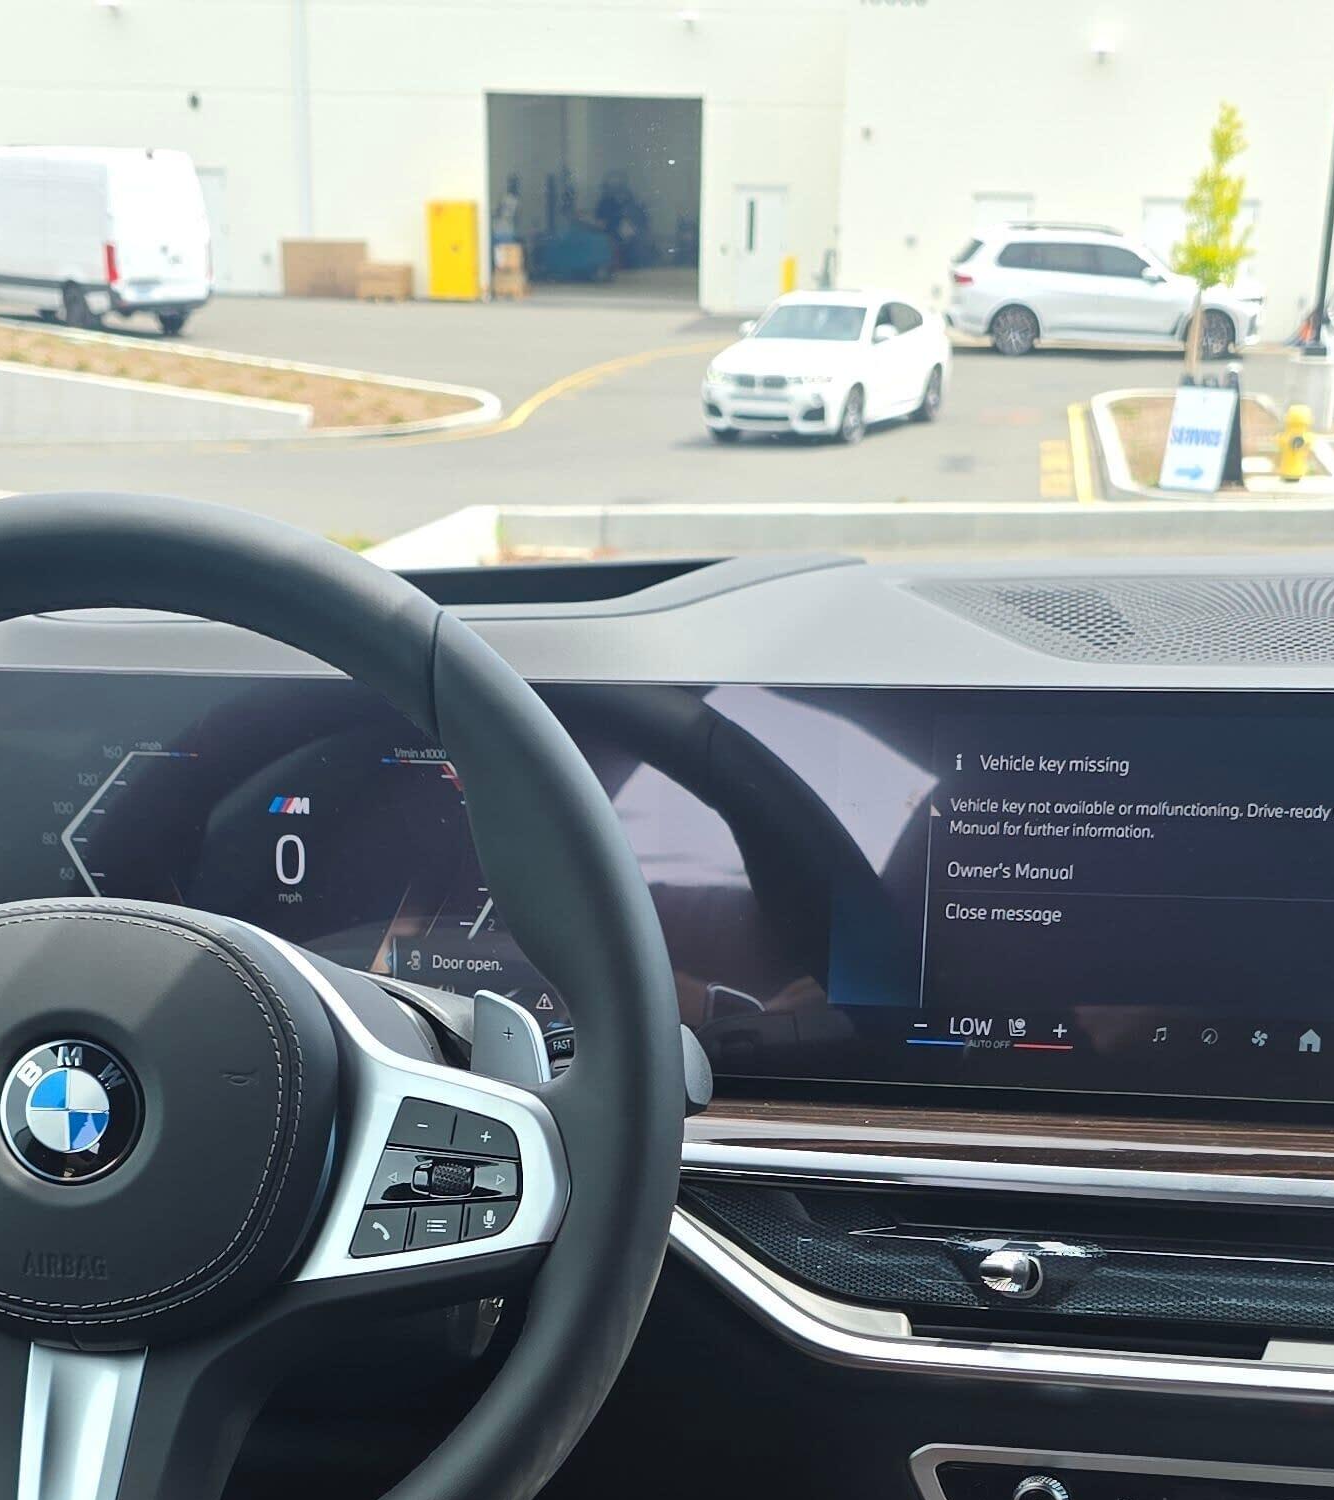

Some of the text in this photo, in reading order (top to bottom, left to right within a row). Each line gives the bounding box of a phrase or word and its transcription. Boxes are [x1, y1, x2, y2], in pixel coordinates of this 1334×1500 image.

[980, 754, 1130, 777] Vehicle key missing
[950, 798, 999, 815] Vehicle
[1002, 799, 1026, 817] key
[1028, 801, 1051, 816] not
[1054, 800, 1116, 817] available
[1118, 804, 1134, 817] or
[1135, 801, 1244, 821] malfunctioning.
[1246, 803, 1332, 822] Drive-ready
[949, 820, 1155, 840] Manual for further information.
[275, 834, 306, 885] 0
[947, 861, 1074, 881] Owner's Manual
[278, 892, 303, 904] mph
[945, 904, 1063, 926] Close message
[432, 954, 504, 973] Door open.
[949, 1017, 993, 1036] LOW
[552, 1039, 571, 1051] FAST
[968, 1039, 1011, 1049] AUTO OFF
[16, 1046, 126, 1091] BMW
[21, 1250, 108, 1280] AIRBAG
